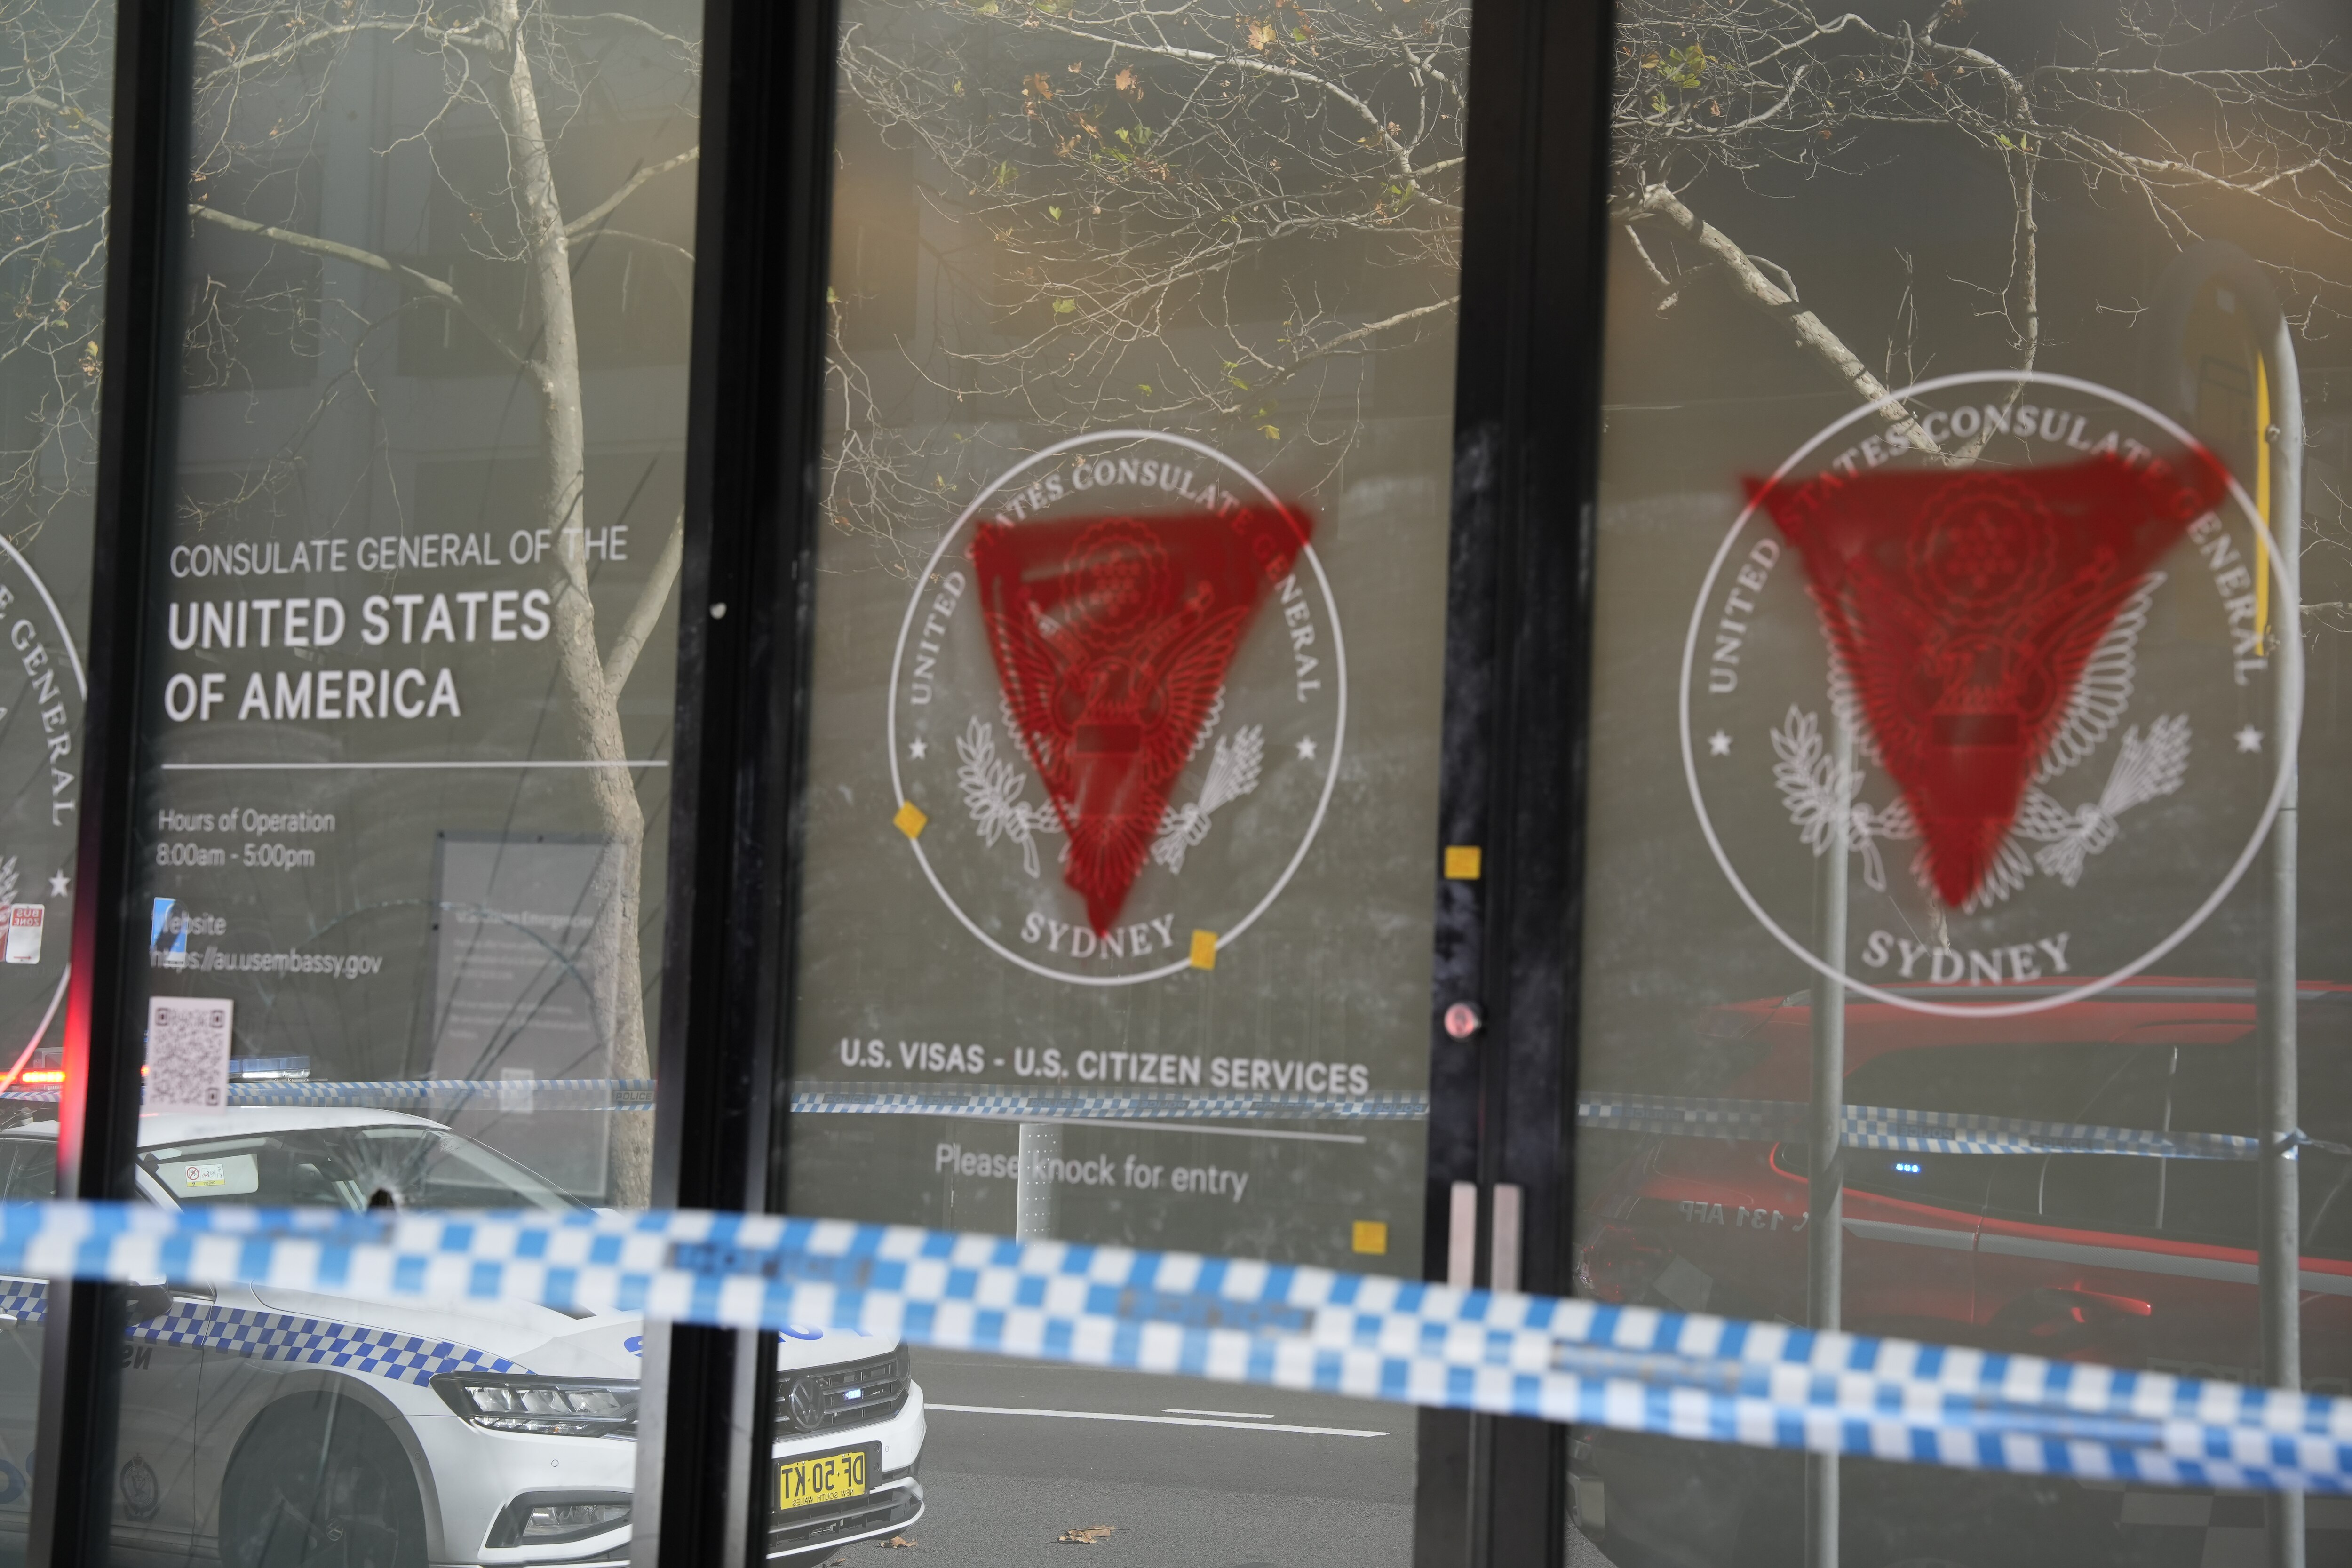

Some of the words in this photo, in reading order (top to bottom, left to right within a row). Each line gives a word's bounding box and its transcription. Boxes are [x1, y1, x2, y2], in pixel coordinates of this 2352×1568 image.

[169, 538, 348, 578] CONSULATE
[357, 533, 500, 573] GENERAL
[509, 529, 552, 565] OF
[562, 525, 629, 561] THE
[168, 597, 346, 650] UNITED
[361, 588, 552, 645] STATES
[910, 569, 966, 706] UNITED
[1709, 537, 1780, 695] UNITED
[9, 617, 77, 827] GENERAL
[164, 673, 226, 722] OF
[237, 667, 461, 720] AMERICA
[158, 808, 215, 832] Hours
[218, 807, 239, 832] of
[241, 808, 336, 837] Operation
[1019, 911, 1177, 961] SYDNEY
[1860, 928, 2072, 986] SYDNEY
[841, 1037, 892, 1069] U.S.
[898, 1041, 985, 1074] VISAS
[1014, 1047, 1069, 1079] U.S.
[1077, 1050, 1201, 1086] CITIZEN
[1211, 1057, 1370, 1095] SERVICES
[615, 1092, 652, 1100] POLICE
[826, 1095, 867, 1104] POLICE
[1029, 1098, 1074, 1107] POLICE
[935, 1142, 1020, 1180] Please
[1123, 1154, 1165, 1189] for
[1171, 1164, 1249, 1203] entry
